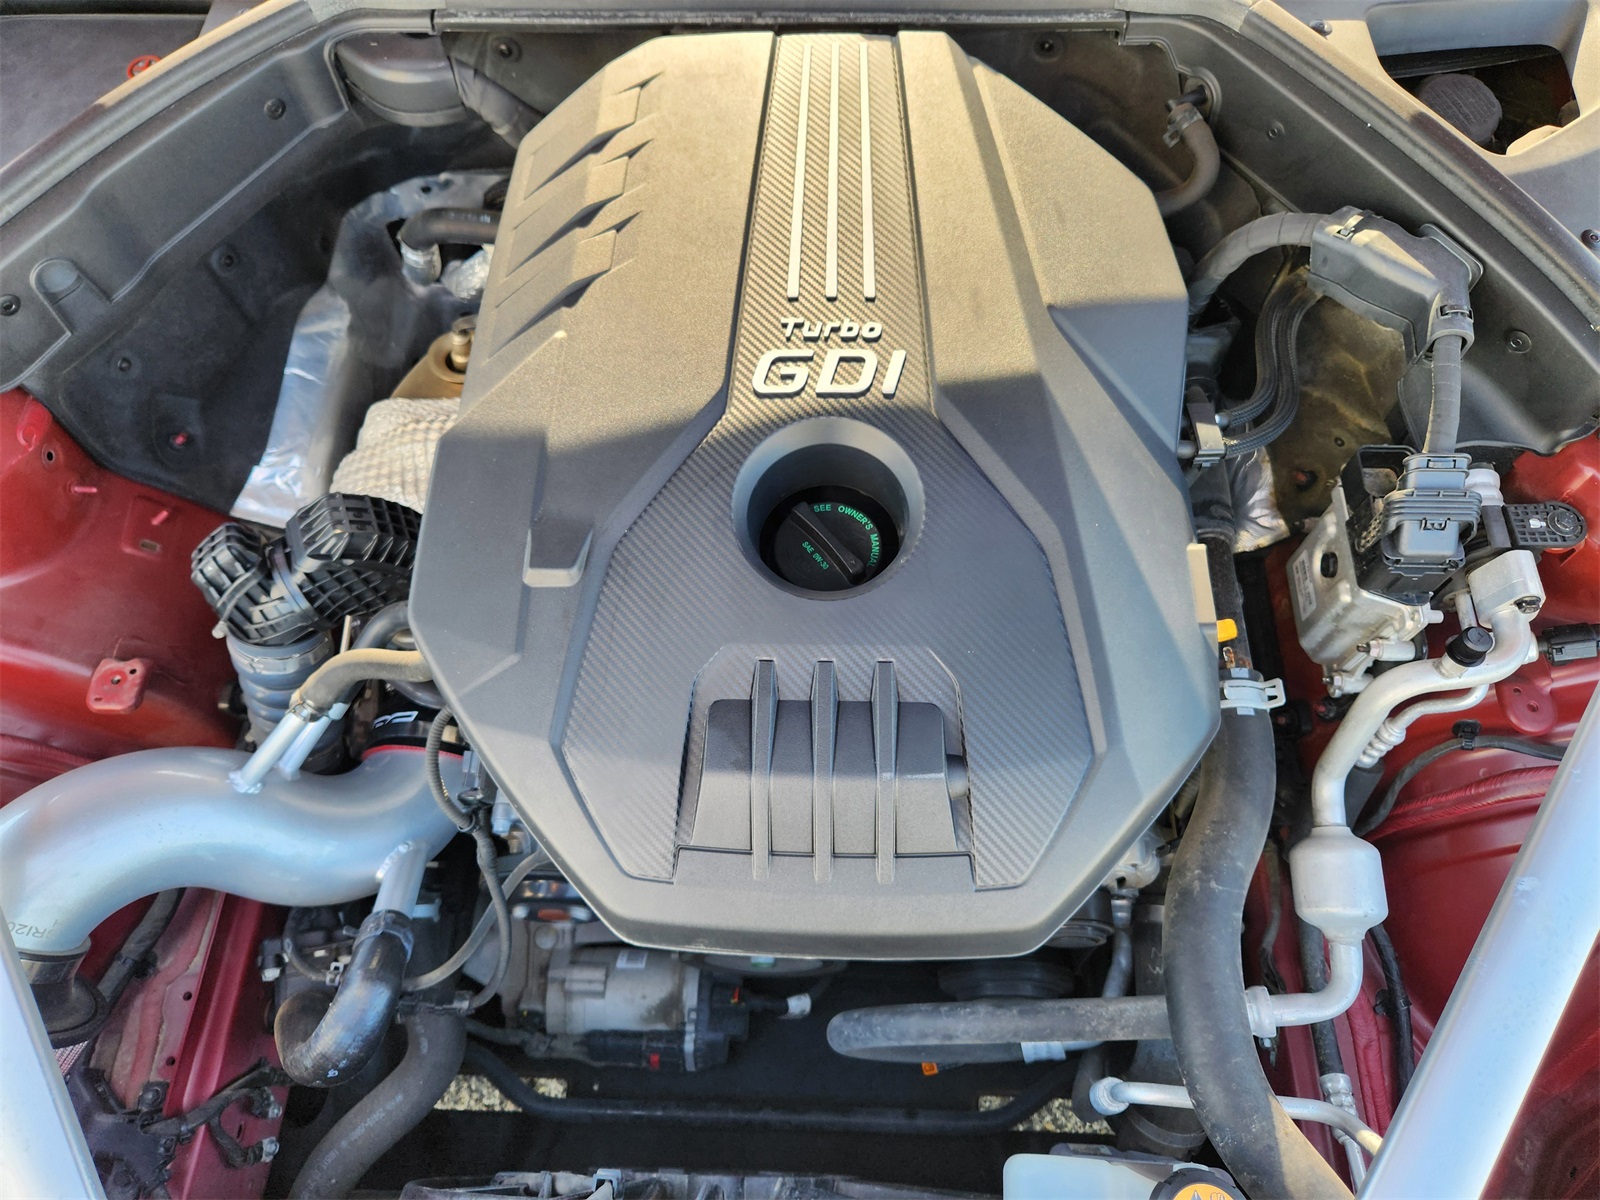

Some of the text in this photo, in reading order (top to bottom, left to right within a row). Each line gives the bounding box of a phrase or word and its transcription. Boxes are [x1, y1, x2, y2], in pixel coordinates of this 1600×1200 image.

[781, 316, 883, 342] Turbo
[752, 349, 907, 399] GDI
[813, 503, 880, 568] SEE OWNER'S MANUAL
[801, 541, 830, 570] SAE 0W-30
